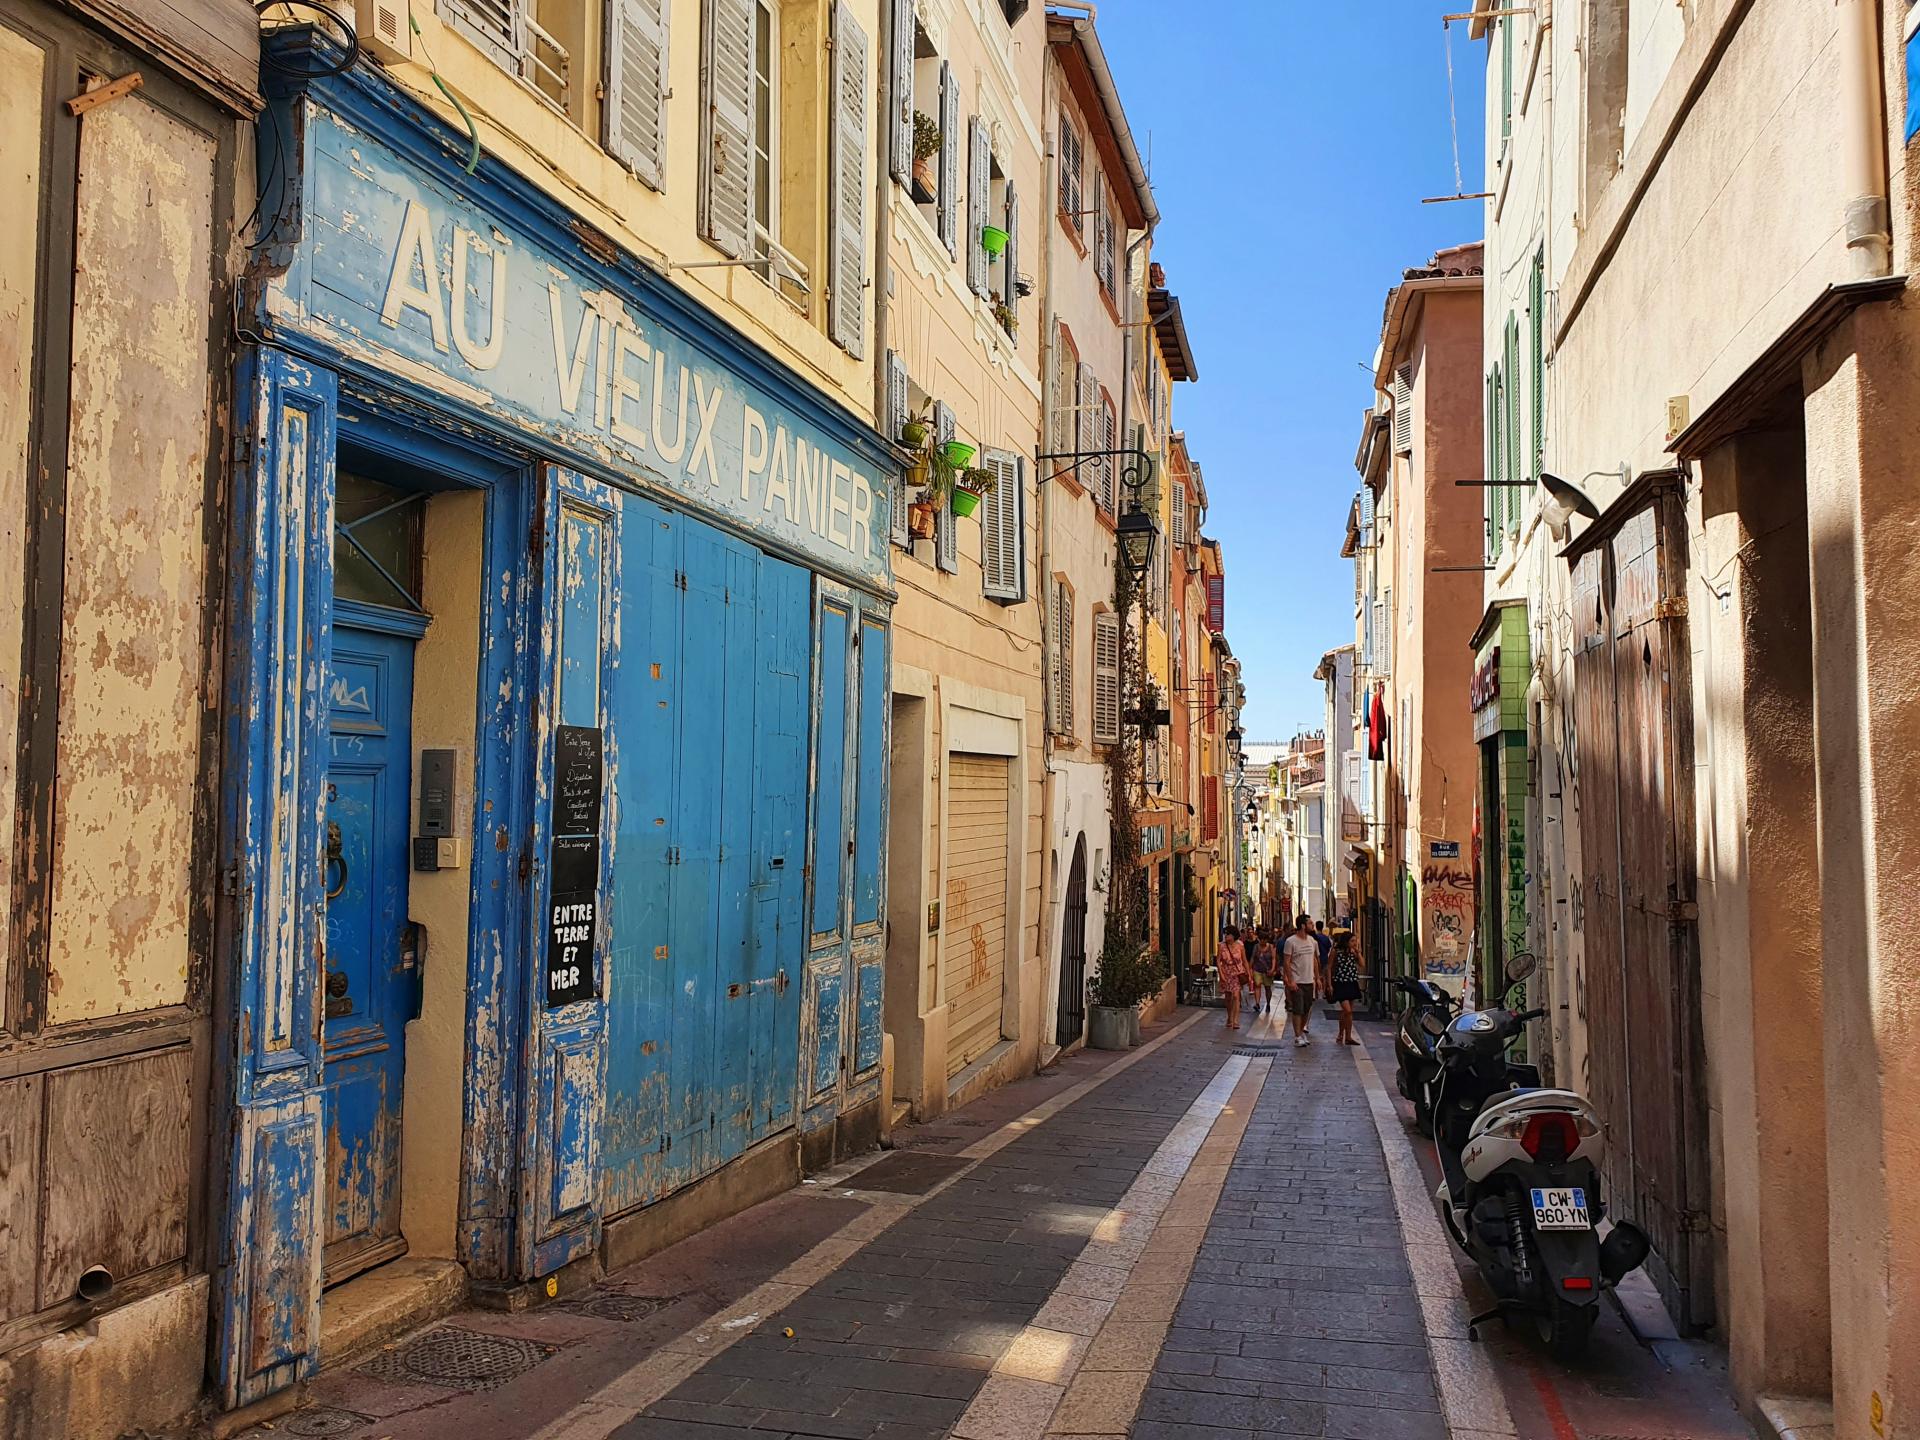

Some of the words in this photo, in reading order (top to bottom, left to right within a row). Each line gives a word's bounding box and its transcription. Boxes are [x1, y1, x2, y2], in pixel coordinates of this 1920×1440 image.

[379, 199, 508, 371] AU
[547, 282, 724, 488] VIEUX
[740, 403, 874, 561] PANIER
[553, 904, 592, 925] ENTRE
[554, 925, 589, 944] TERRE
[563, 946, 578, 963] ET
[551, 966, 580, 991] MER
[1548, 1192, 1571, 1206] CW-
[1536, 1208, 1588, 1224] 960-YN
